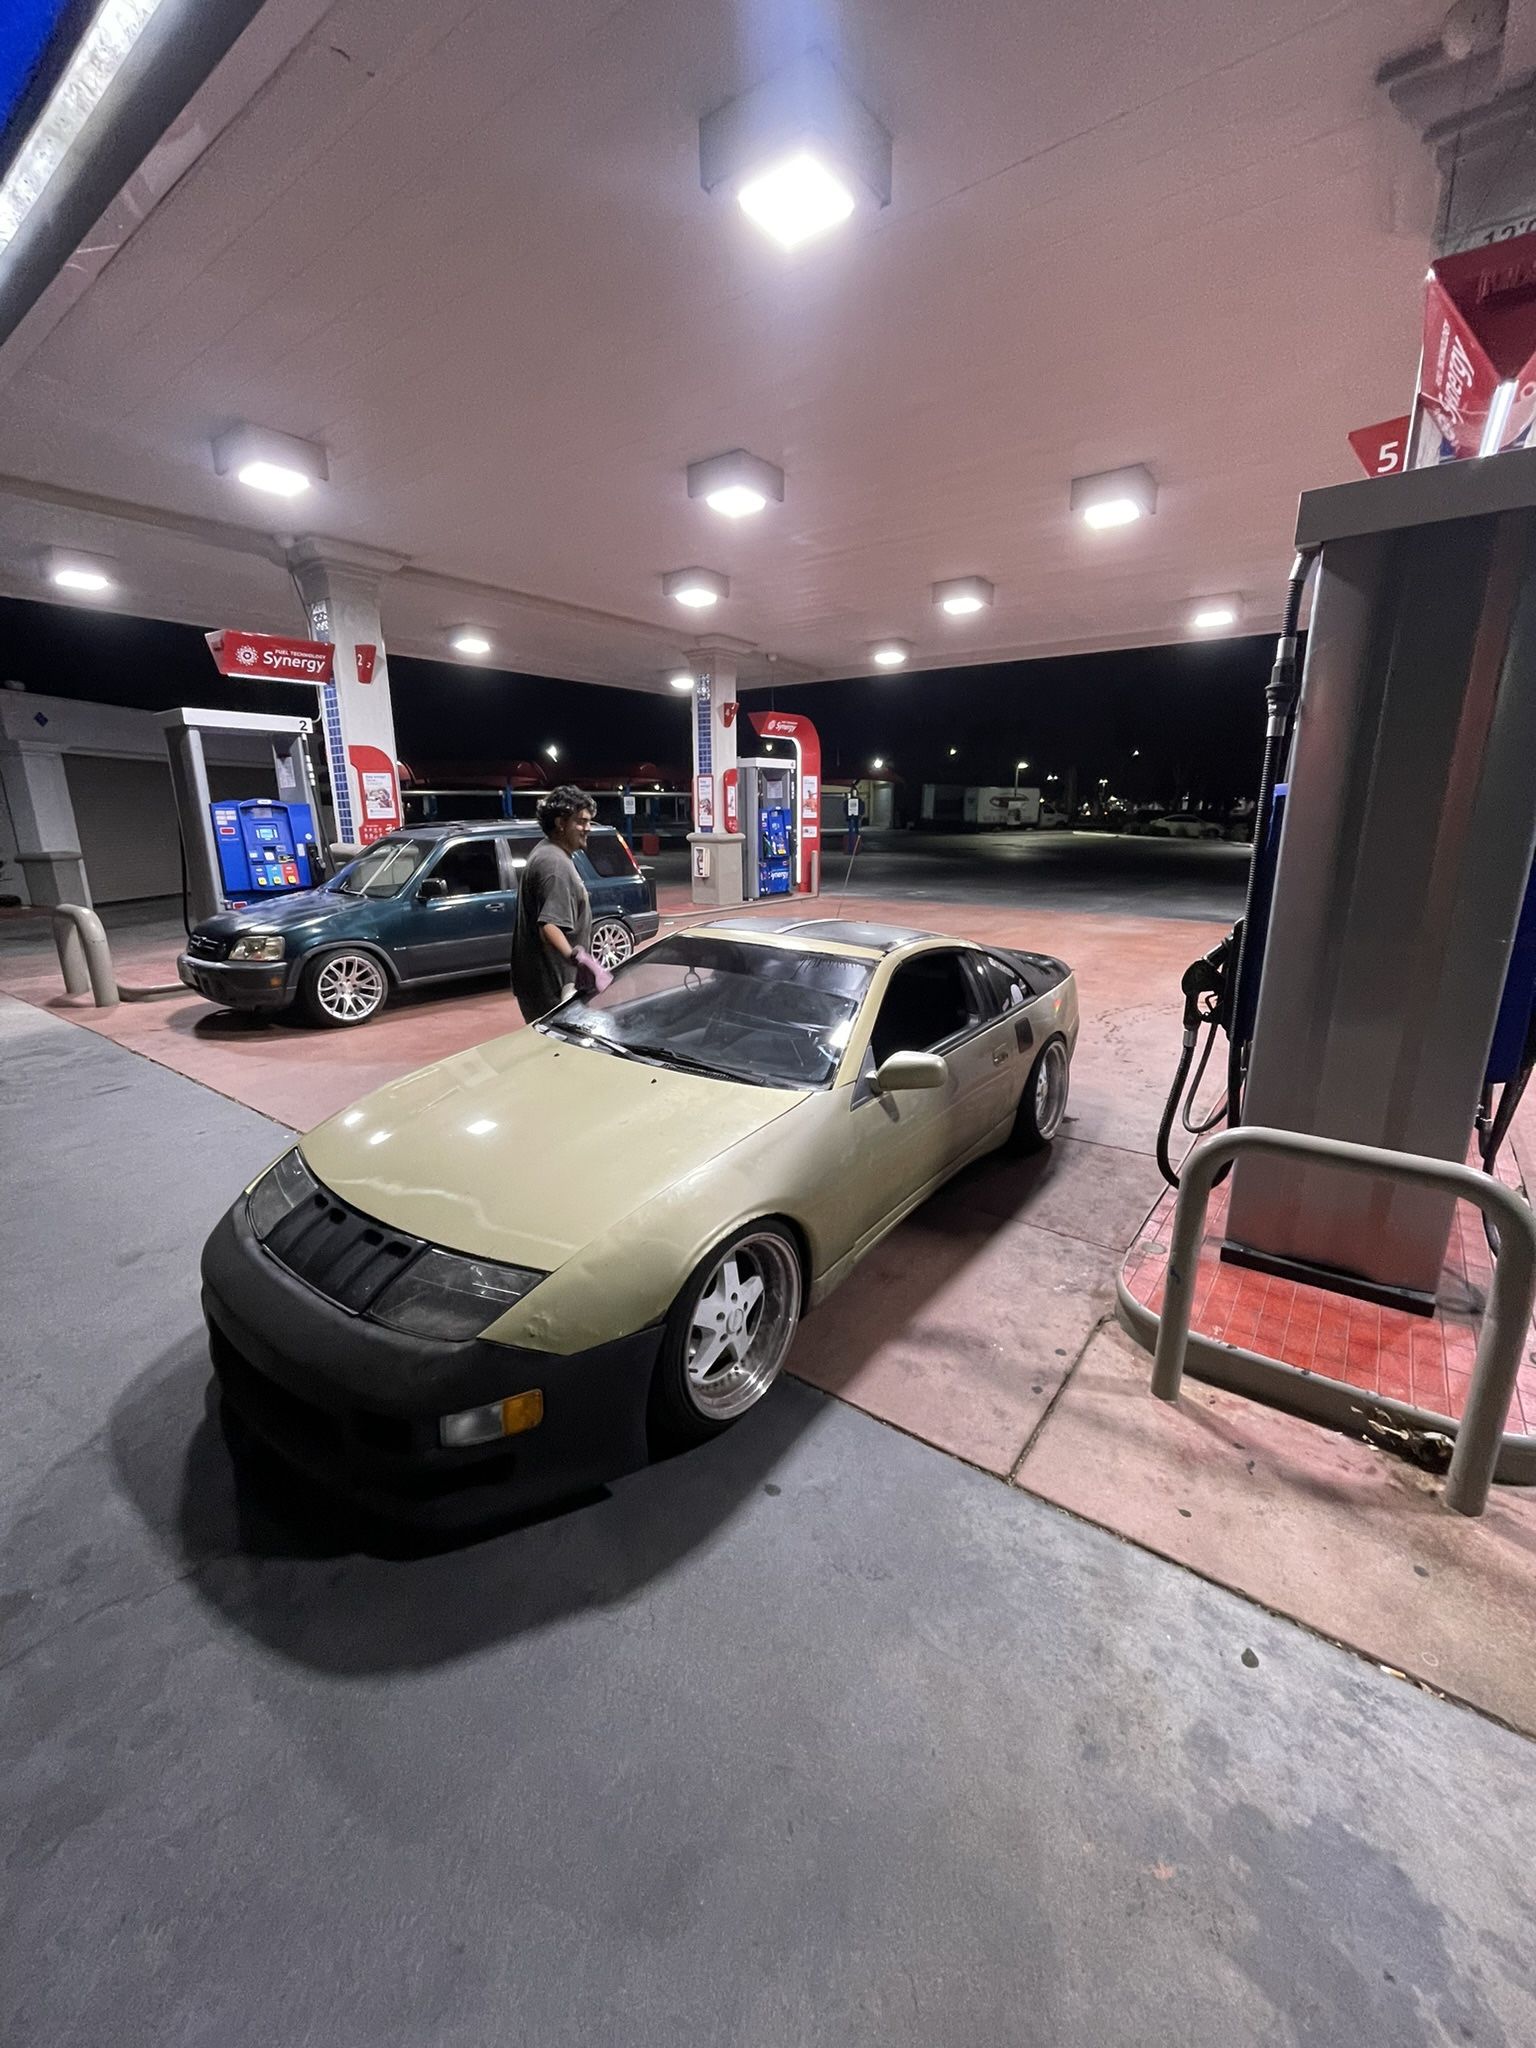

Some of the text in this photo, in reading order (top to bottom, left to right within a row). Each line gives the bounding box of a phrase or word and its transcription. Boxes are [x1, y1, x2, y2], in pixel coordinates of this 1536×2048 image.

[1438, 335, 1475, 424] Synergy
[1377, 441, 1399, 473] 5
[263, 651, 326, 673] Synergy
[357, 653, 363, 666] 2
[299, 720, 308, 731] 2
[775, 721, 798, 733] Synergy
